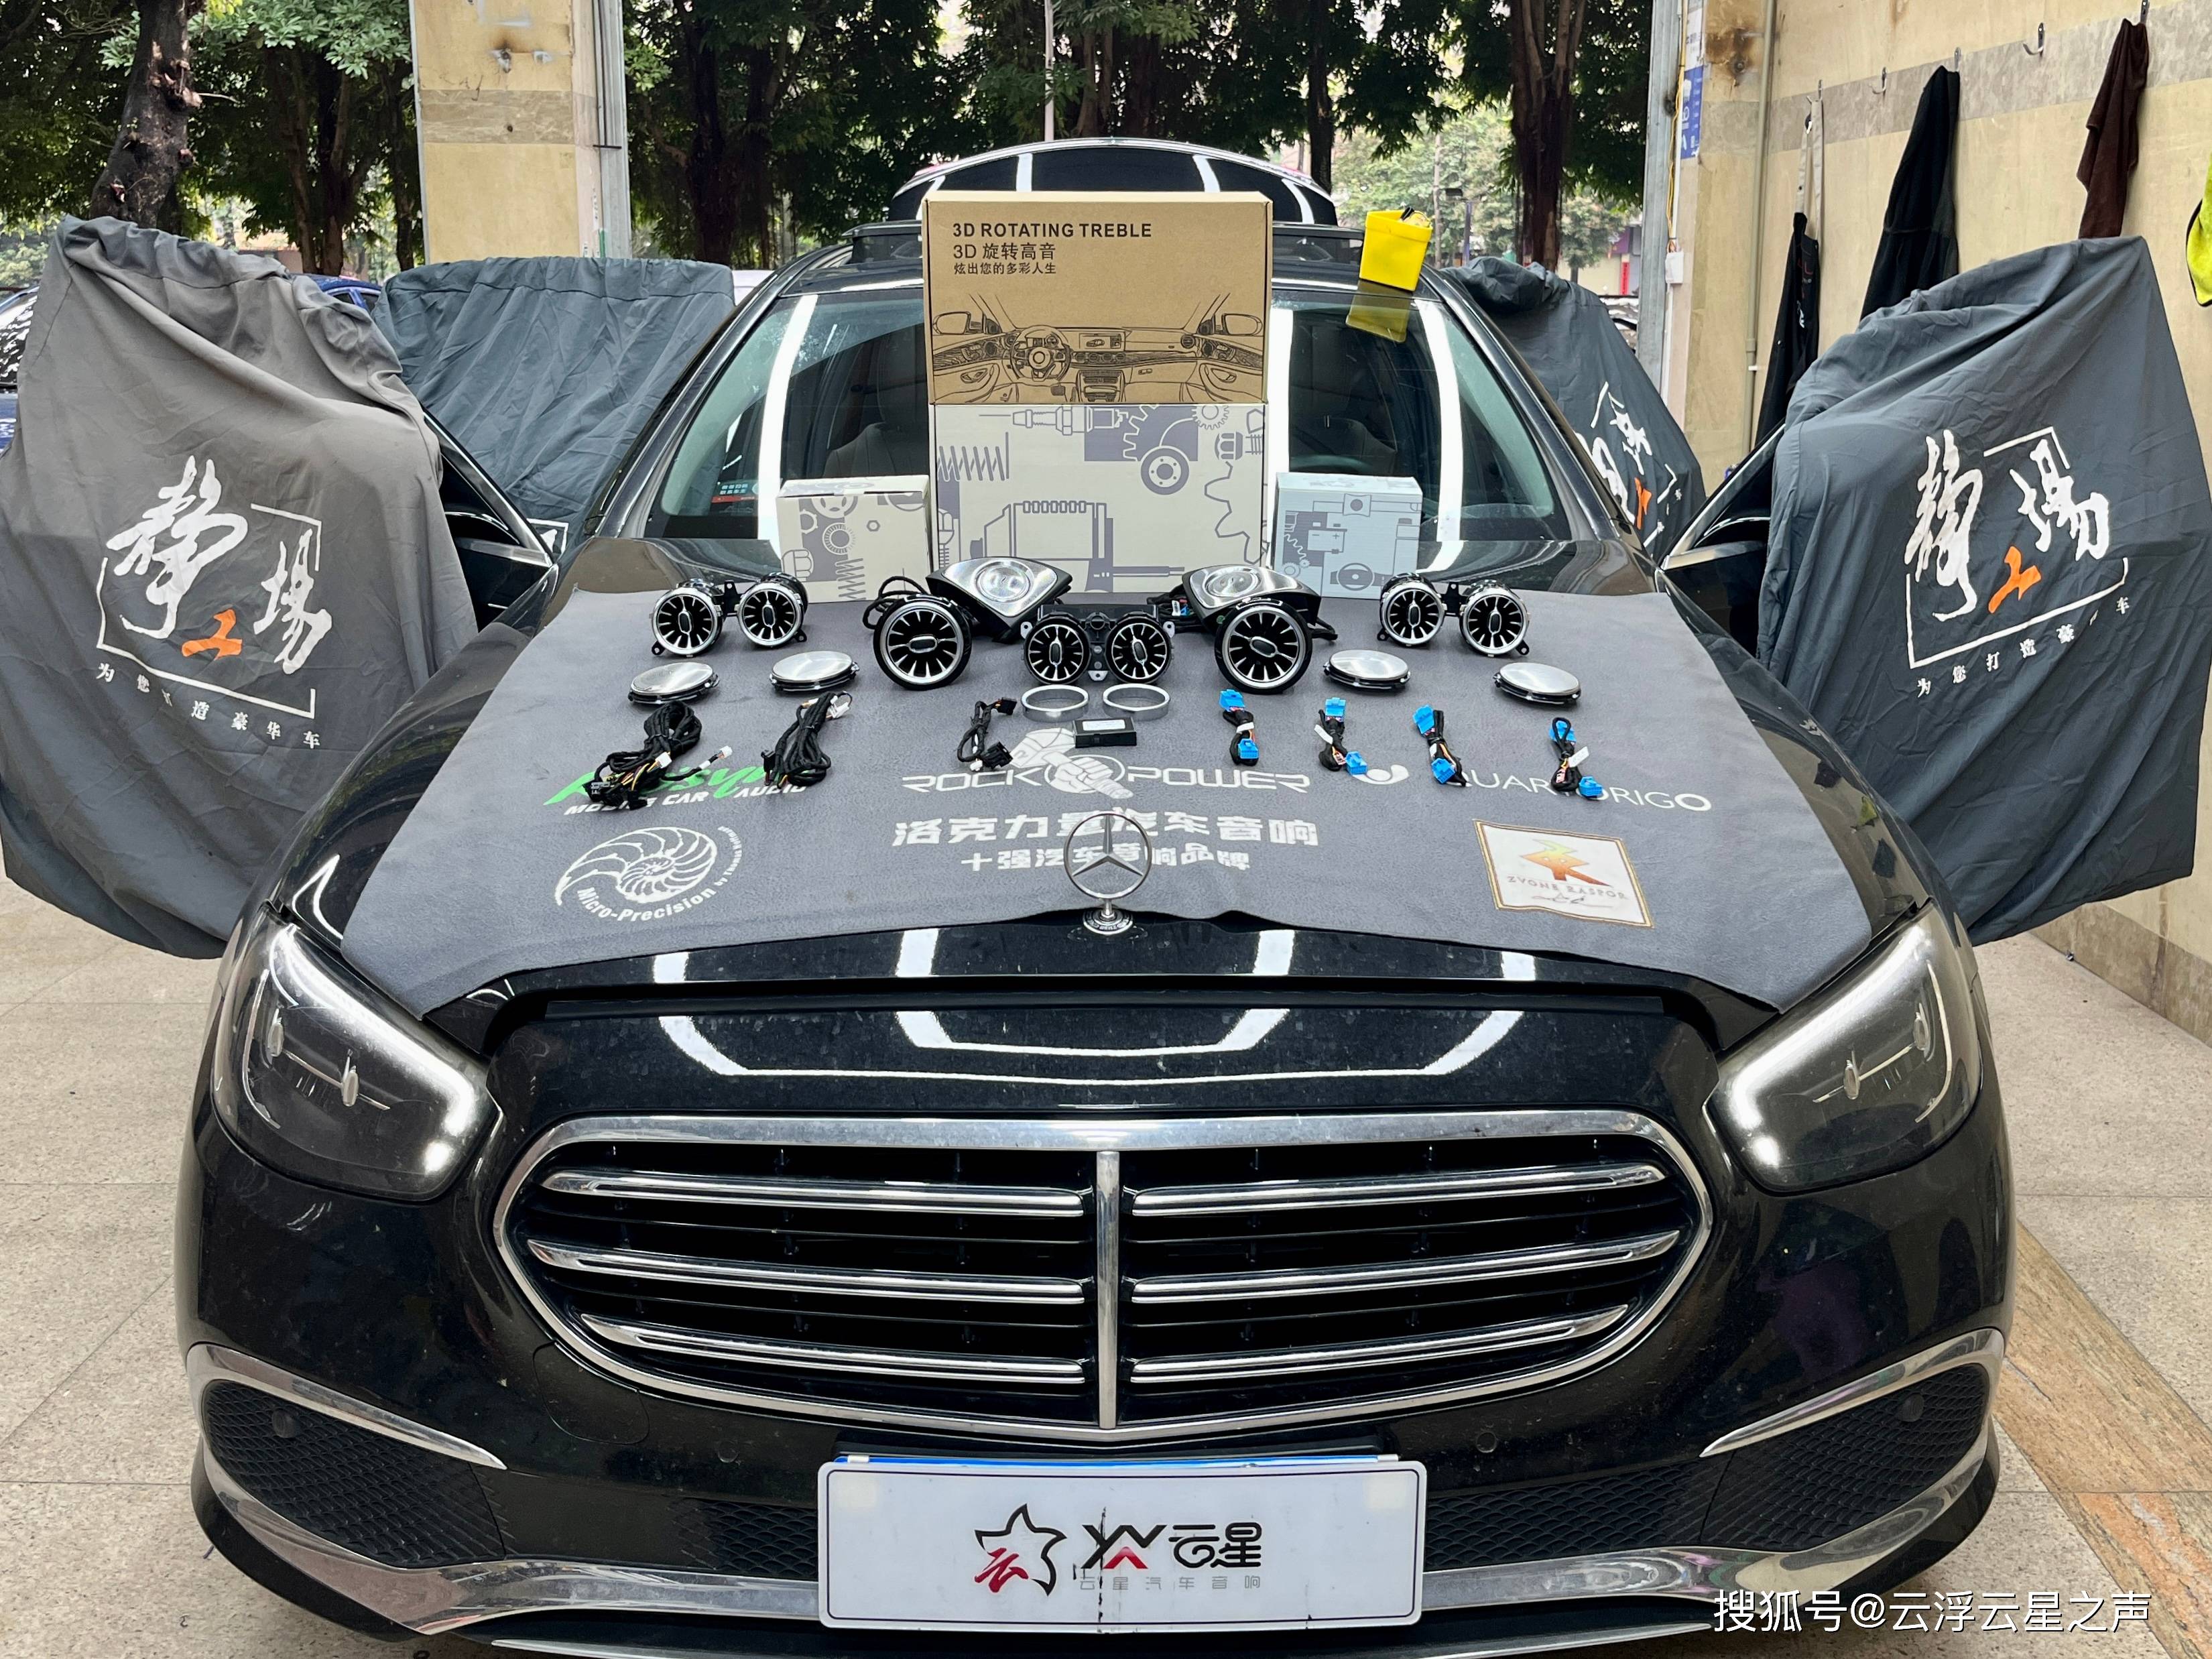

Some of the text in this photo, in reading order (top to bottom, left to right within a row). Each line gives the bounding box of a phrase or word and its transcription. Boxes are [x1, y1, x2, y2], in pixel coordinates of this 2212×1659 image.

[953, 223, 1152, 237] 3D ROTATING TREBLE
[953, 242, 1056, 260] 3D 旋转高音
[954, 262, 1057, 275] 炫出您的多彩人生
[902, 766, 1310, 794] ROCK POWER
[662, 791, 710, 806] CAR
[892, 806, 1318, 847] 洛克力量汽车音响
[576, 886, 717, 922] Micro-Precision
[1168, 1521, 1263, 1569] 云星
[1079, 1575, 1262, 1591] 云星汽车音响
